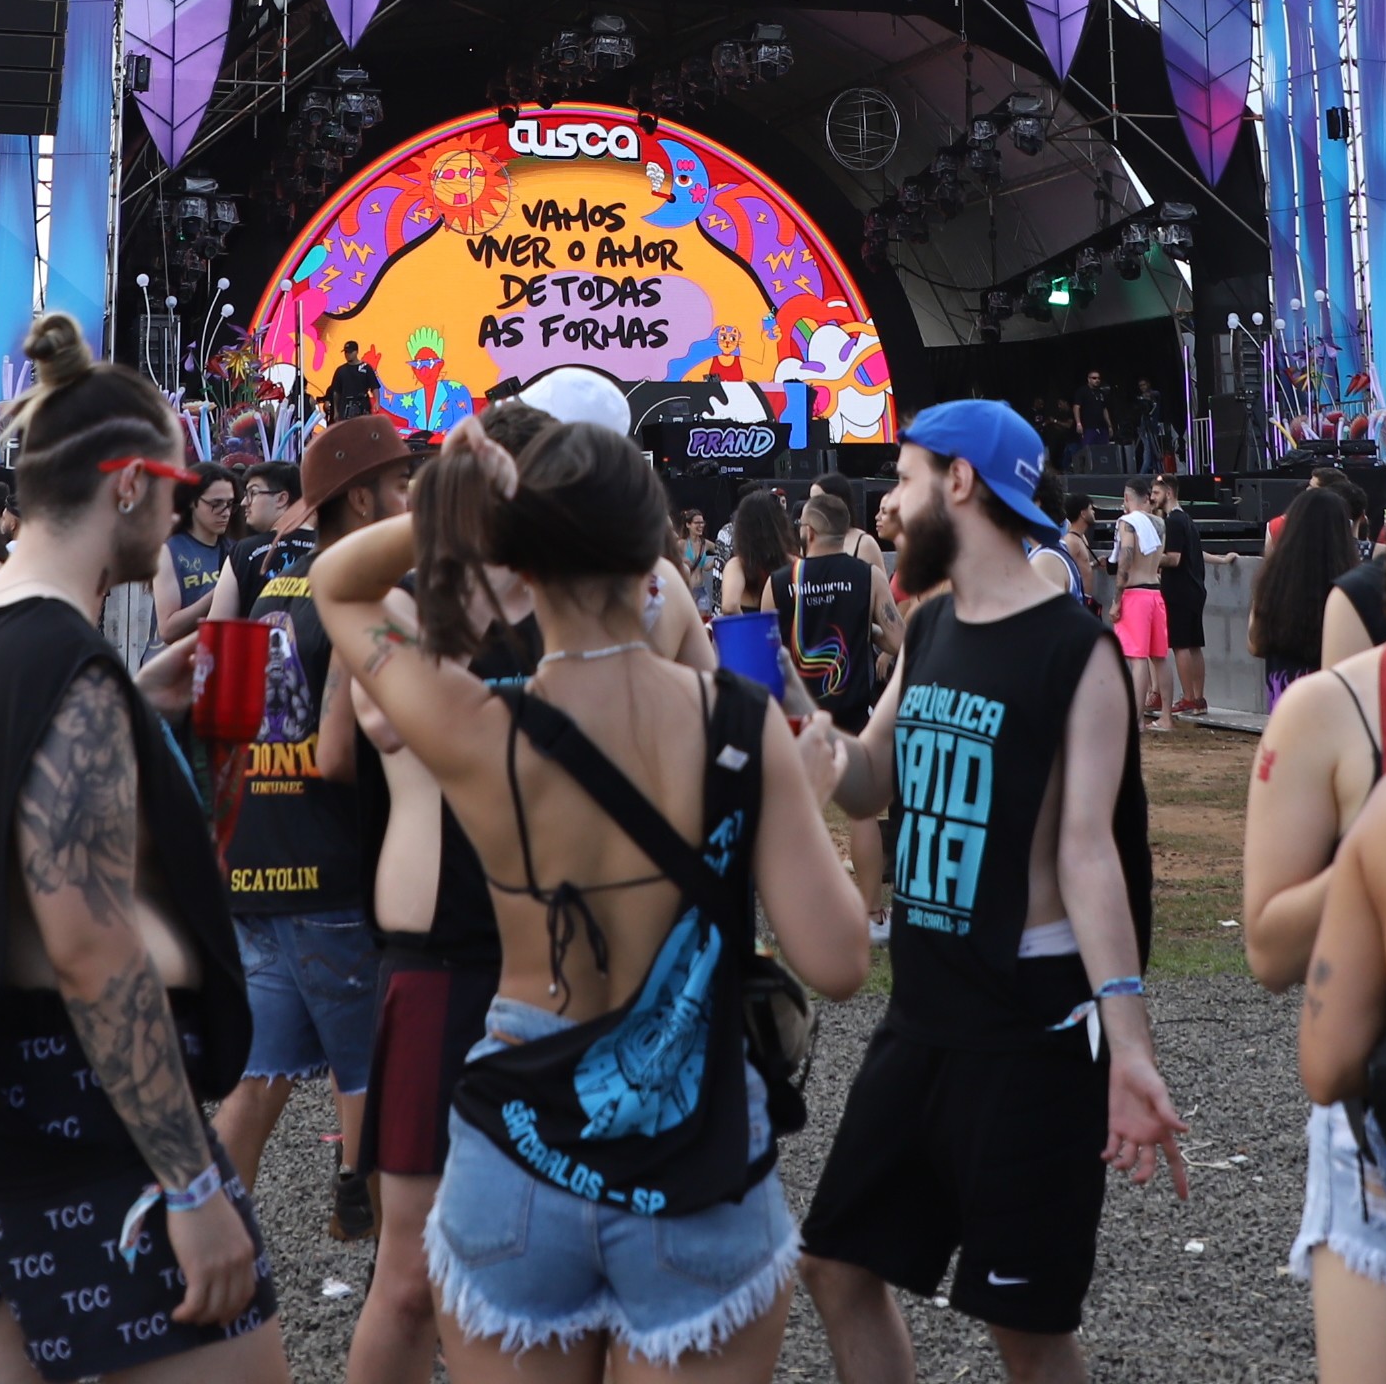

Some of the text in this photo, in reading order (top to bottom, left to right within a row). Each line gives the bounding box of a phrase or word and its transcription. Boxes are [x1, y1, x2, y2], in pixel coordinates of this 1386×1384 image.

[508, 119, 641, 161] tusca
[522, 198, 626, 233] VAMOS
[466, 234, 683, 272] VIVER O AMOR
[496, 273, 662, 311] DE TODAS
[478, 314, 669, 350] AS FORMAS
[687, 426, 775, 458] PRAND
[230, 866, 319, 892] SCATOLIN
[44, 1201, 95, 1231] TCC
[631, 1186, 667, 1215] SP
[8, 1251, 56, 1281] TCC
[61, 1283, 112, 1315] TCC
[117, 1310, 168, 1345] TCC
[29, 1335, 72, 1362] TCC
